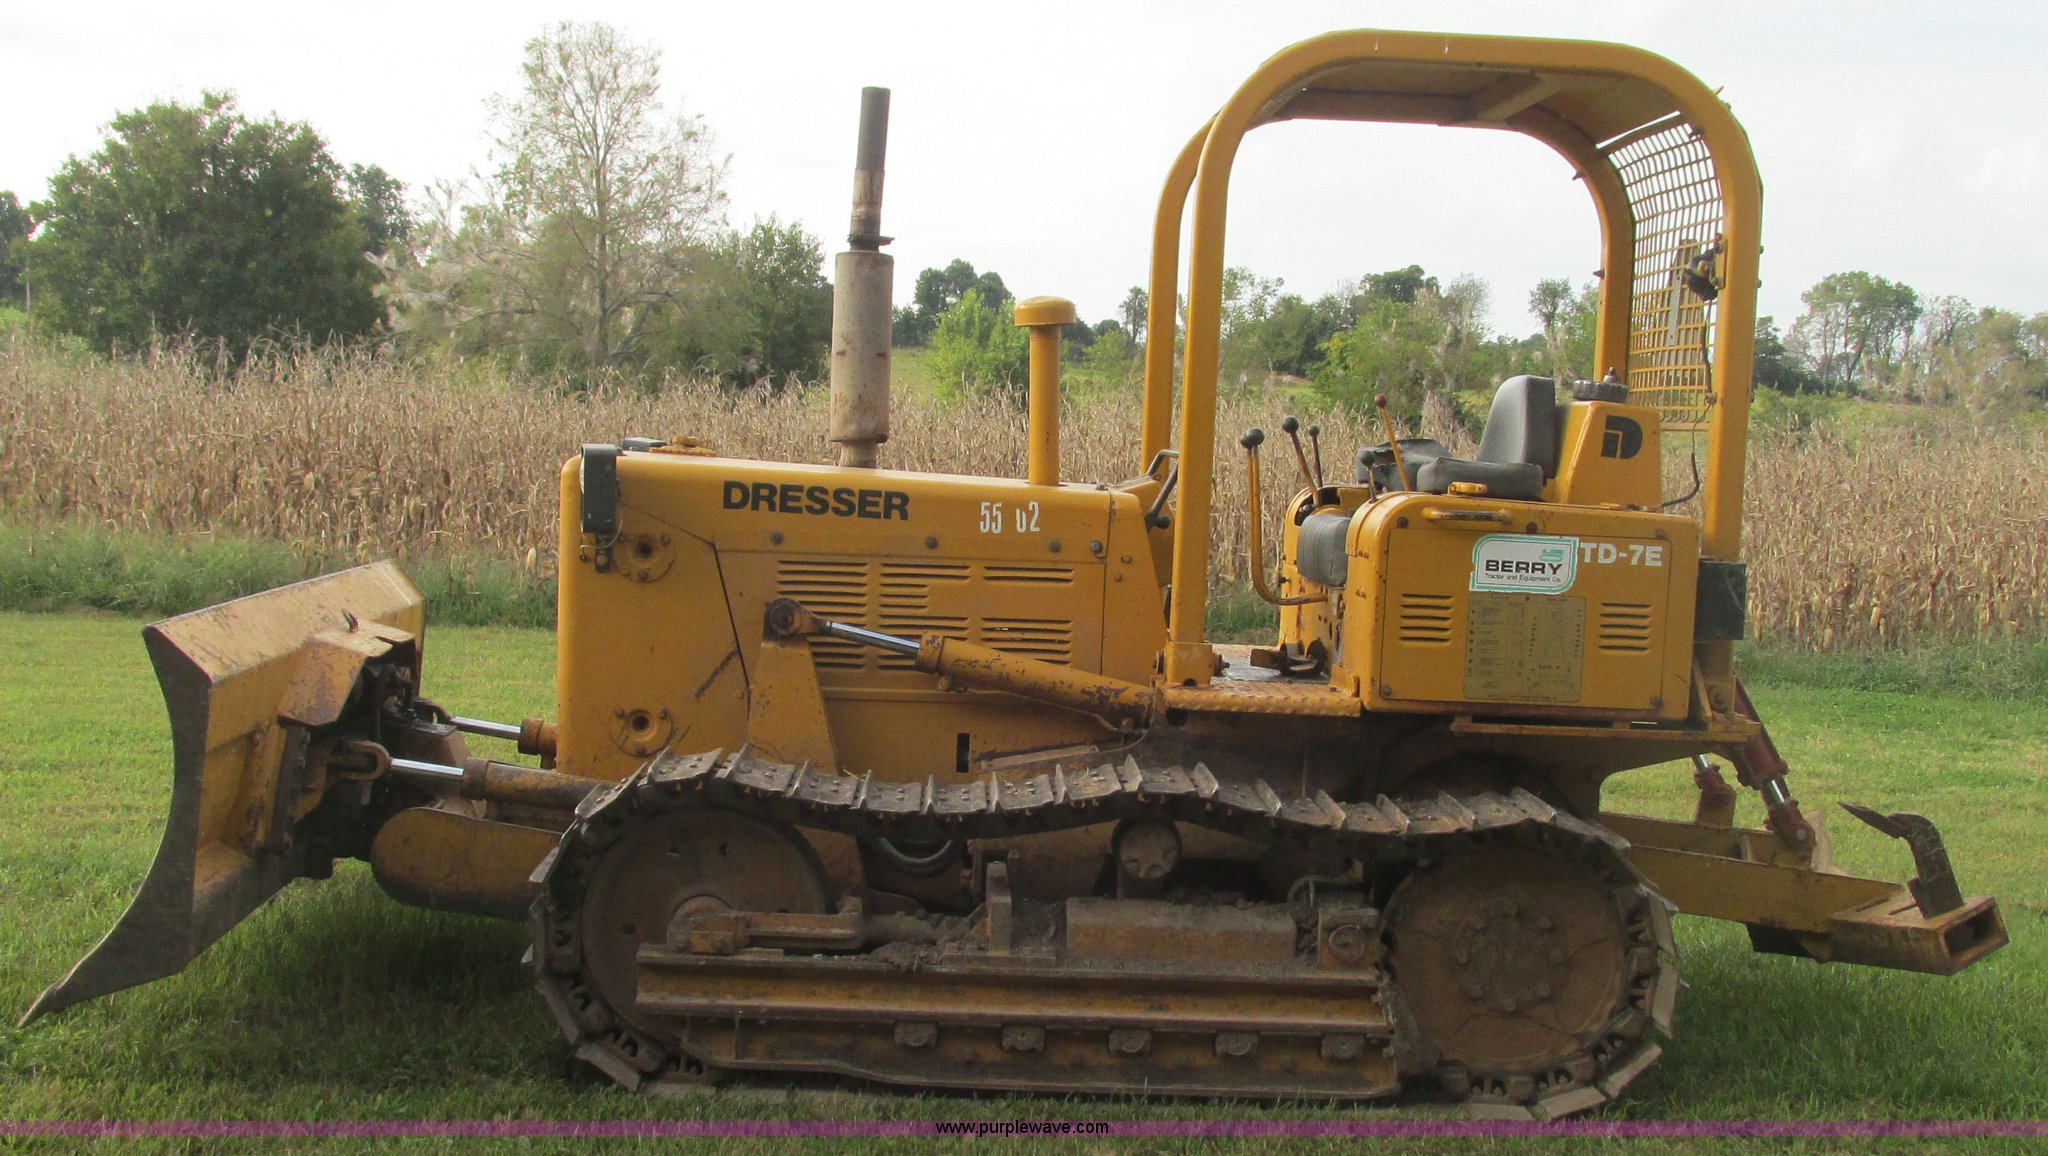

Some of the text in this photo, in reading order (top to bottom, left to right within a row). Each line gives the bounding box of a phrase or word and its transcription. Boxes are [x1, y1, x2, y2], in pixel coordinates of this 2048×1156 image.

[723, 480, 910, 521] DRESSER
[980, 501, 1002, 533] 55
[1580, 542, 1664, 567] TD-7E
[1485, 559, 1562, 576] BERRY
[1485, 572, 1505, 580] Tractor
[1519, 574, 1551, 583] Equipment
